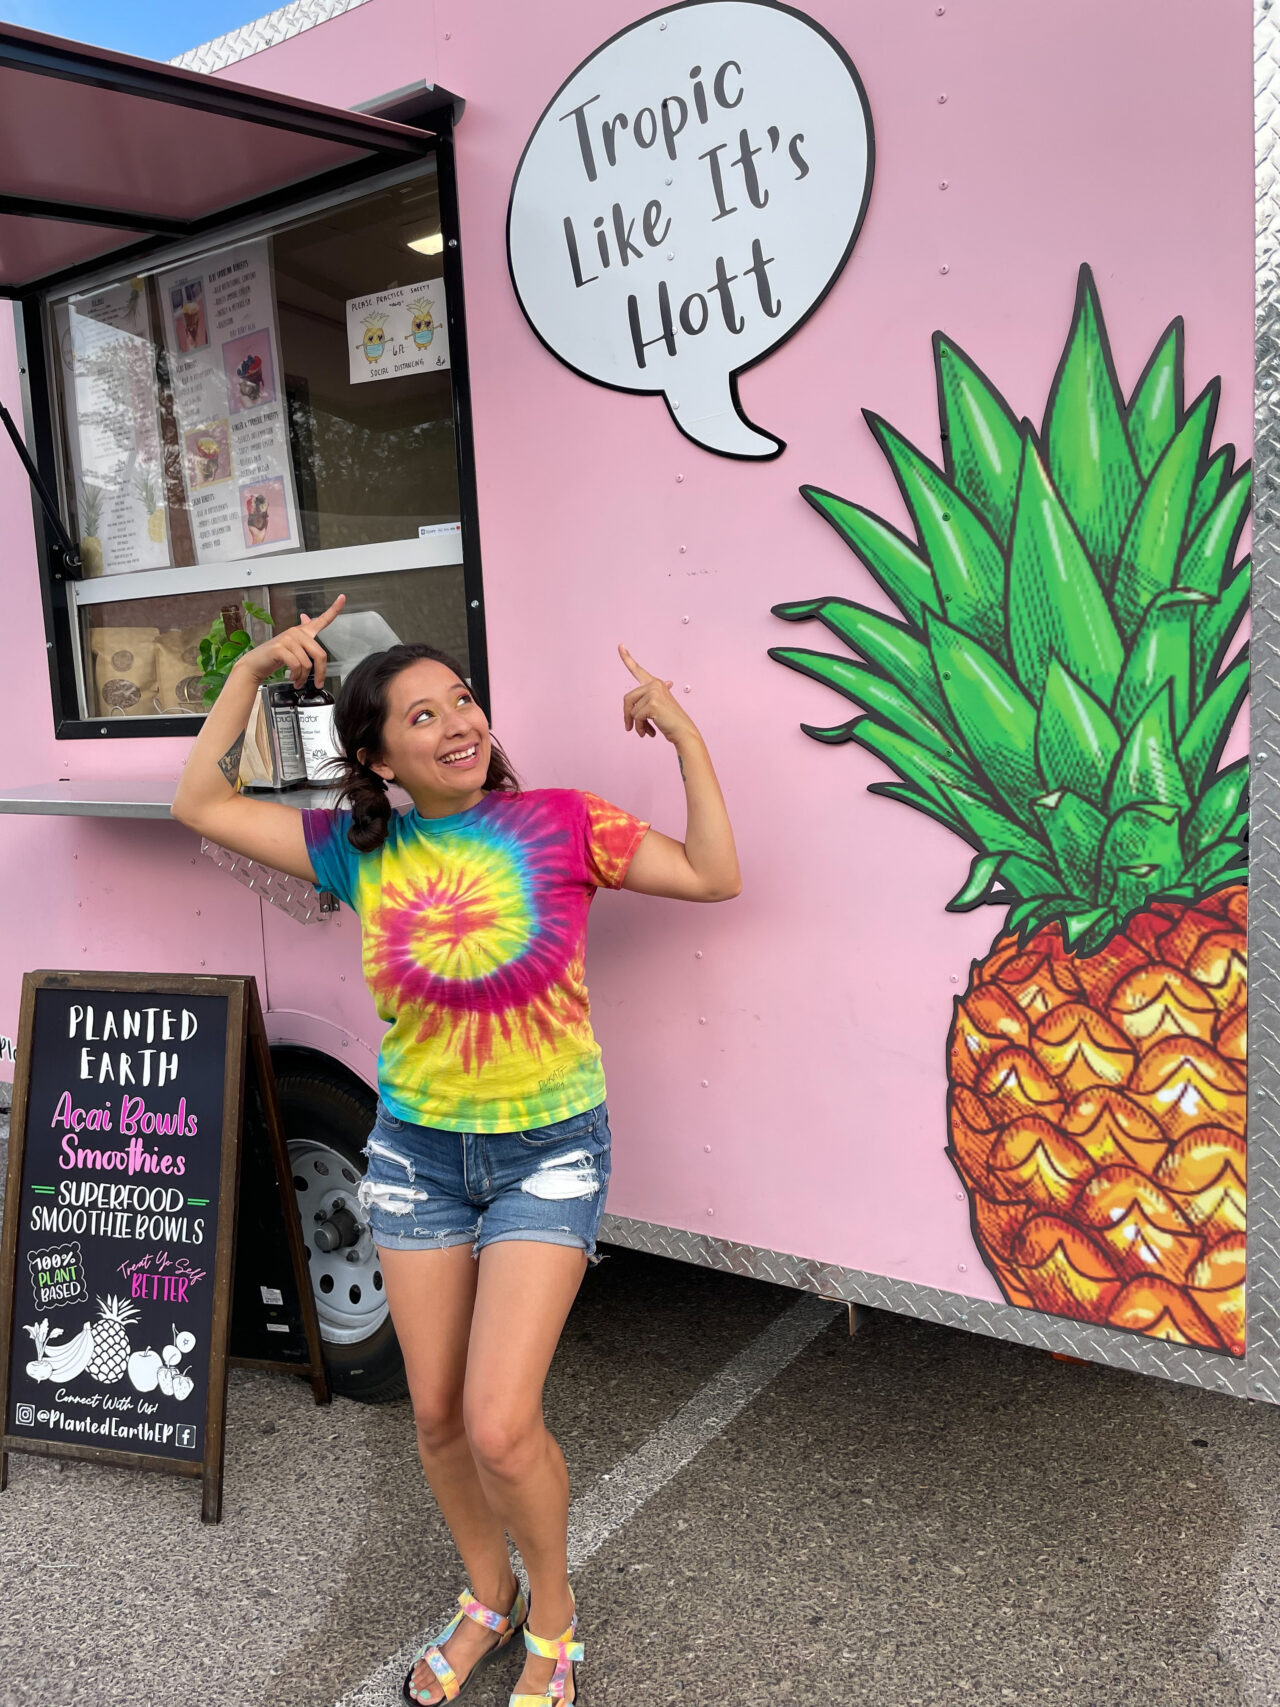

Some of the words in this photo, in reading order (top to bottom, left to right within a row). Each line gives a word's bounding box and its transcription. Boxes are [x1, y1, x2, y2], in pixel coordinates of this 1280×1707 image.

[559, 60, 744, 183] Tropic
[563, 199, 672, 289] Like
[698, 126, 810, 222] It's
[351, 299, 373, 312] PLEASE
[376, 290, 404, 305] PRACTICE
[410, 284, 430, 294] SAFETY
[627, 238, 782, 369] Hott
[370, 367, 389, 378] SOCIAL
[394, 358, 425, 372] DISTANCING
[69, 1004, 198, 1044] PLANTED
[79, 1047, 180, 1087] EARTH
[51, 1091, 113, 1132] Açai
[119, 1094, 198, 1137] Bowls
[58, 1133, 186, 1176] Smoothies
[58, 1180, 184, 1213] SUPERFOOD
[30, 1206, 132, 1239] SMOOTHIE
[135, 1214, 205, 1245] BOWLS
[32, 1251, 76, 1271] 100%
[38, 1265, 77, 1287] PLANT
[116, 1253, 154, 1279] Treat
[155, 1250, 173, 1272] Yo
[175, 1258, 207, 1285] Self
[40, 1281, 81, 1302] BASED
[131, 1272, 189, 1303] BETTER
[55, 1388, 102, 1408] Connect
[102, 1394, 134, 1411] With
[137, 1399, 158, 1415] Us!
[36, 1409, 174, 1444] @PlantedEarthEP
